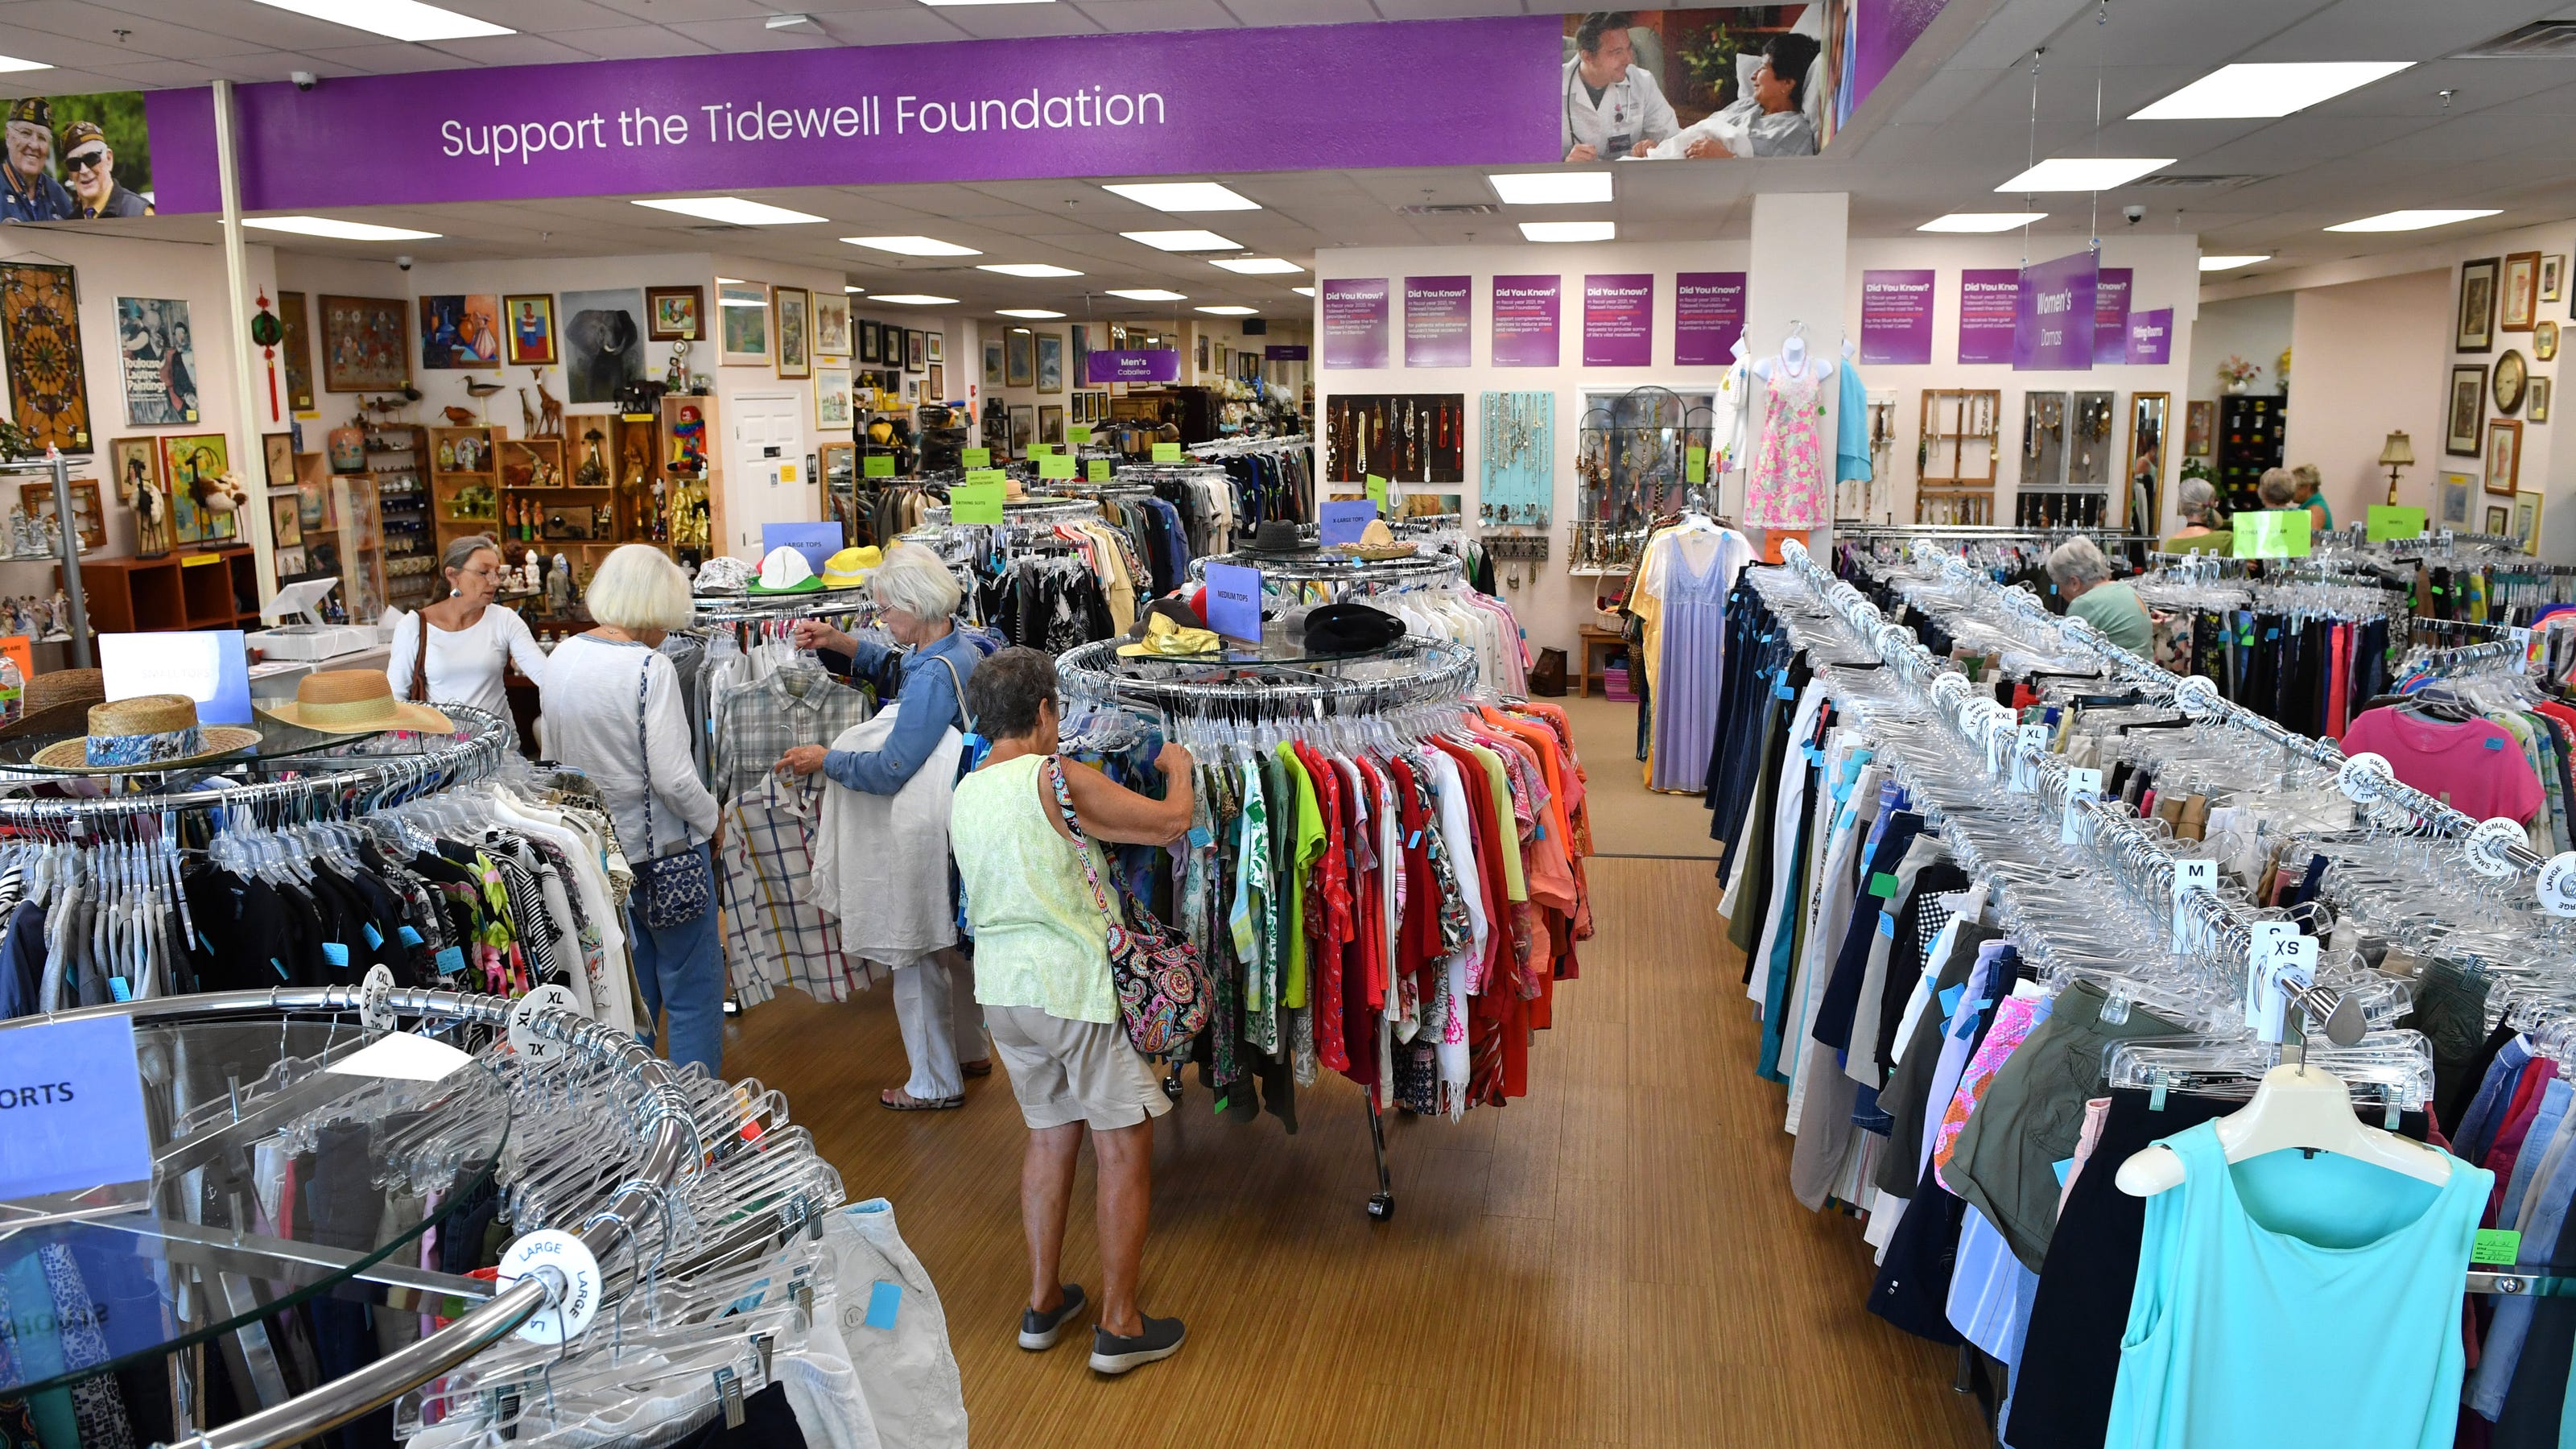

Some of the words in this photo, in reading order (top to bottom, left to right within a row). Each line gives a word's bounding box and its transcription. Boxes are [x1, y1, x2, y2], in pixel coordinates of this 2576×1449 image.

[442, 114, 607, 166] Support
[617, 108, 688, 147] the
[701, 97, 880, 142] Tidewell
[897, 85, 1165, 134] Foundation
[1408, 290, 1422, 298] Did
[1439, 289, 1467, 297] Know?
[1527, 288, 1556, 296] Know?
[1587, 288, 1601, 296] Did
[1619, 287, 1648, 295] Know?
[1679, 286, 1694, 294] Did
[1711, 286, 1740, 294] Know?
[1867, 283, 1881, 291] Did
[1899, 283, 1929, 291] Know?
[1964, 283, 1979, 291] Did
[2098, 283, 2127, 291] Know?
[2037, 288, 2071, 315] Women's
[2041, 328, 2062, 346] Damas
[1121, 358, 1147, 366] Men's
[127, 380, 167, 393] Paintings
[1217, 590, 1236, 601] MEDIUM
[1236, 593, 1249, 602] TOPS
[2178, 680, 2194, 696] MEDIUM
[1995, 712, 2012, 720] XXL
[2026, 729, 2041, 738] XL
[2082, 773, 2088, 782] L
[2344, 762, 2358, 785] SMALL
[2486, 823, 2513, 832] SMALL
[2471, 846, 2492, 870] SMALL
[2189, 865, 2204, 877] M
[2545, 865, 2563, 892] LARGE
[2558, 902, 2576, 910] RGE
[2274, 940, 2300, 956] XS
[376, 968, 389, 986] XXL
[364, 984, 373, 1012] XXL
[547, 991, 564, 1005] XL
[516, 1008, 531, 1027] XL
[528, 1043, 546, 1056] XL
[518, 1241, 563, 1262] LARGE
[568, 1270, 588, 1319] LARGE
